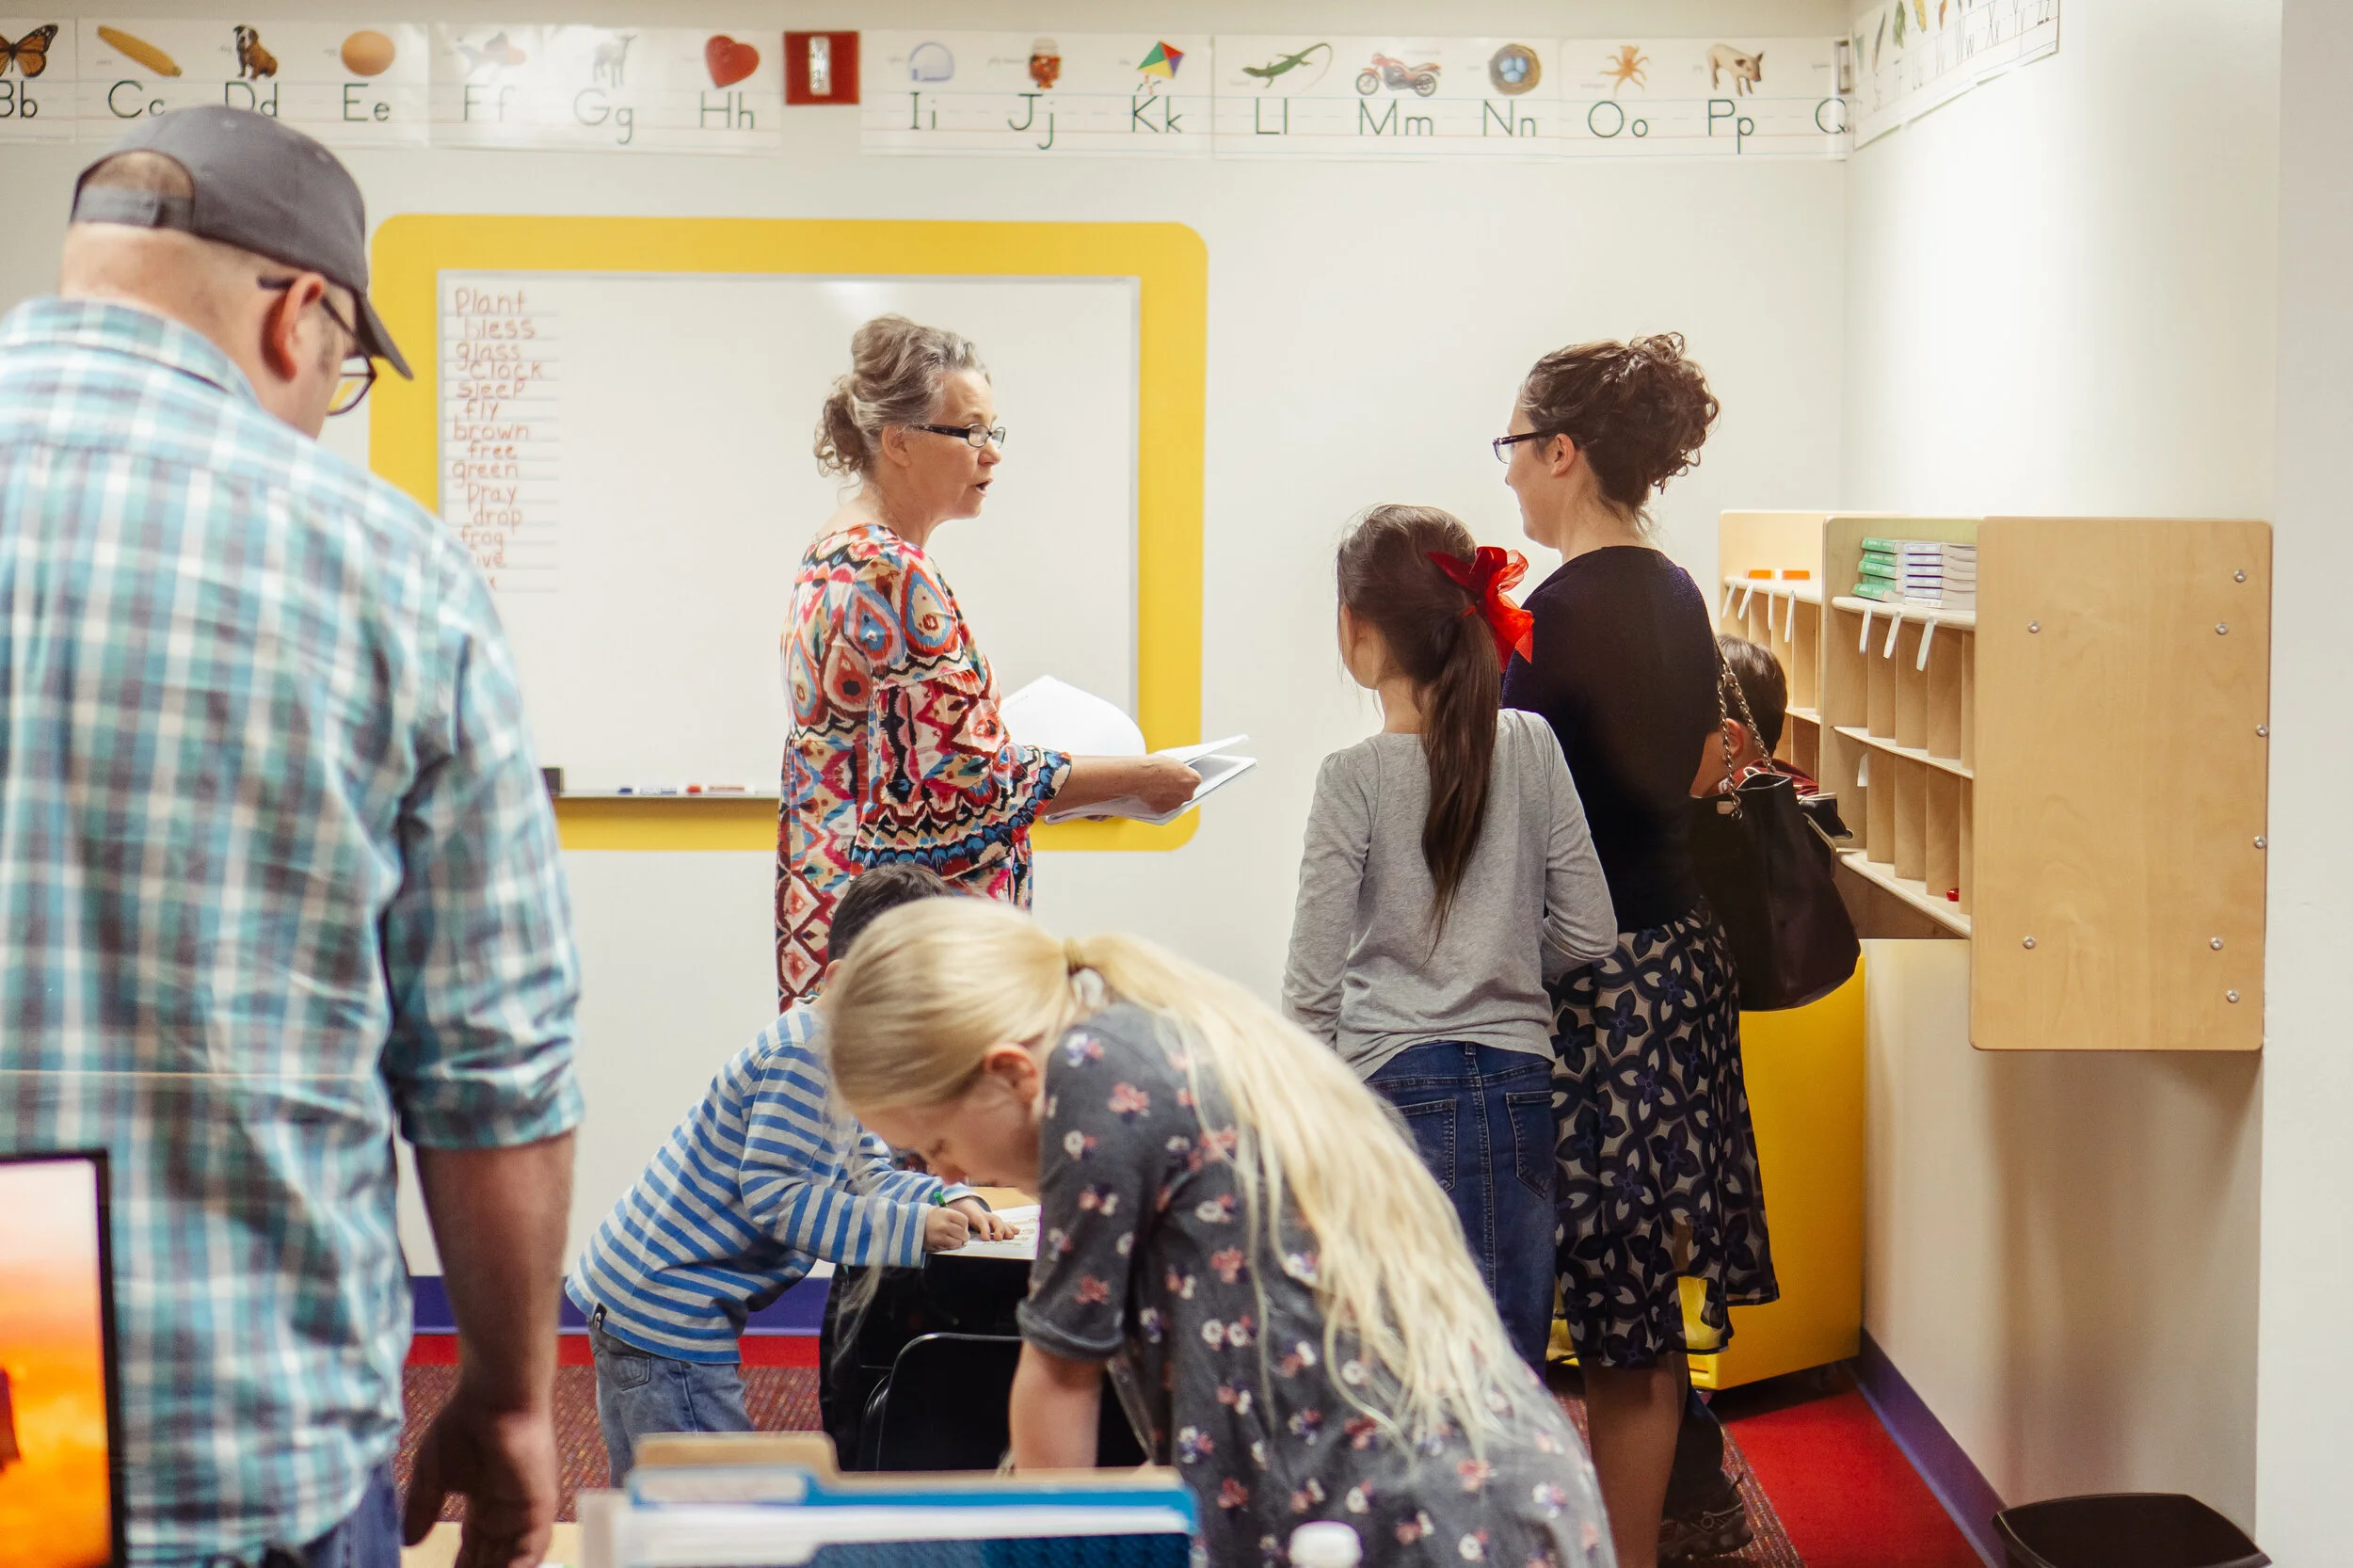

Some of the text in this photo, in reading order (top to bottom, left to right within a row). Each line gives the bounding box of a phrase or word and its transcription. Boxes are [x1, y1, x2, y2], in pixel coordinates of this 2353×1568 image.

[107, 79, 166, 119] Cc
[343, 82, 391, 121] Ee
[463, 83, 517, 122] Ff
[572, 88, 633, 145] Gg
[699, 89, 754, 130] Hh
[1007, 92, 1054, 151] Jj
[1131, 94, 1182, 134] Kk
[1358, 97, 1434, 136] Mm
[1481, 98, 1537, 137] Nn
[1587, 100, 1648, 138] Oo
[1707, 98, 1755, 155] Pp
[464, 315, 536, 340] bless
[455, 340, 520, 372] glass
[455, 376, 527, 399] sleep
[464, 398, 499, 422] fly
[454, 414, 530, 440] brown
[467, 440, 518, 459] free
[452, 459, 519, 488] green
[472, 501, 522, 536] drop
